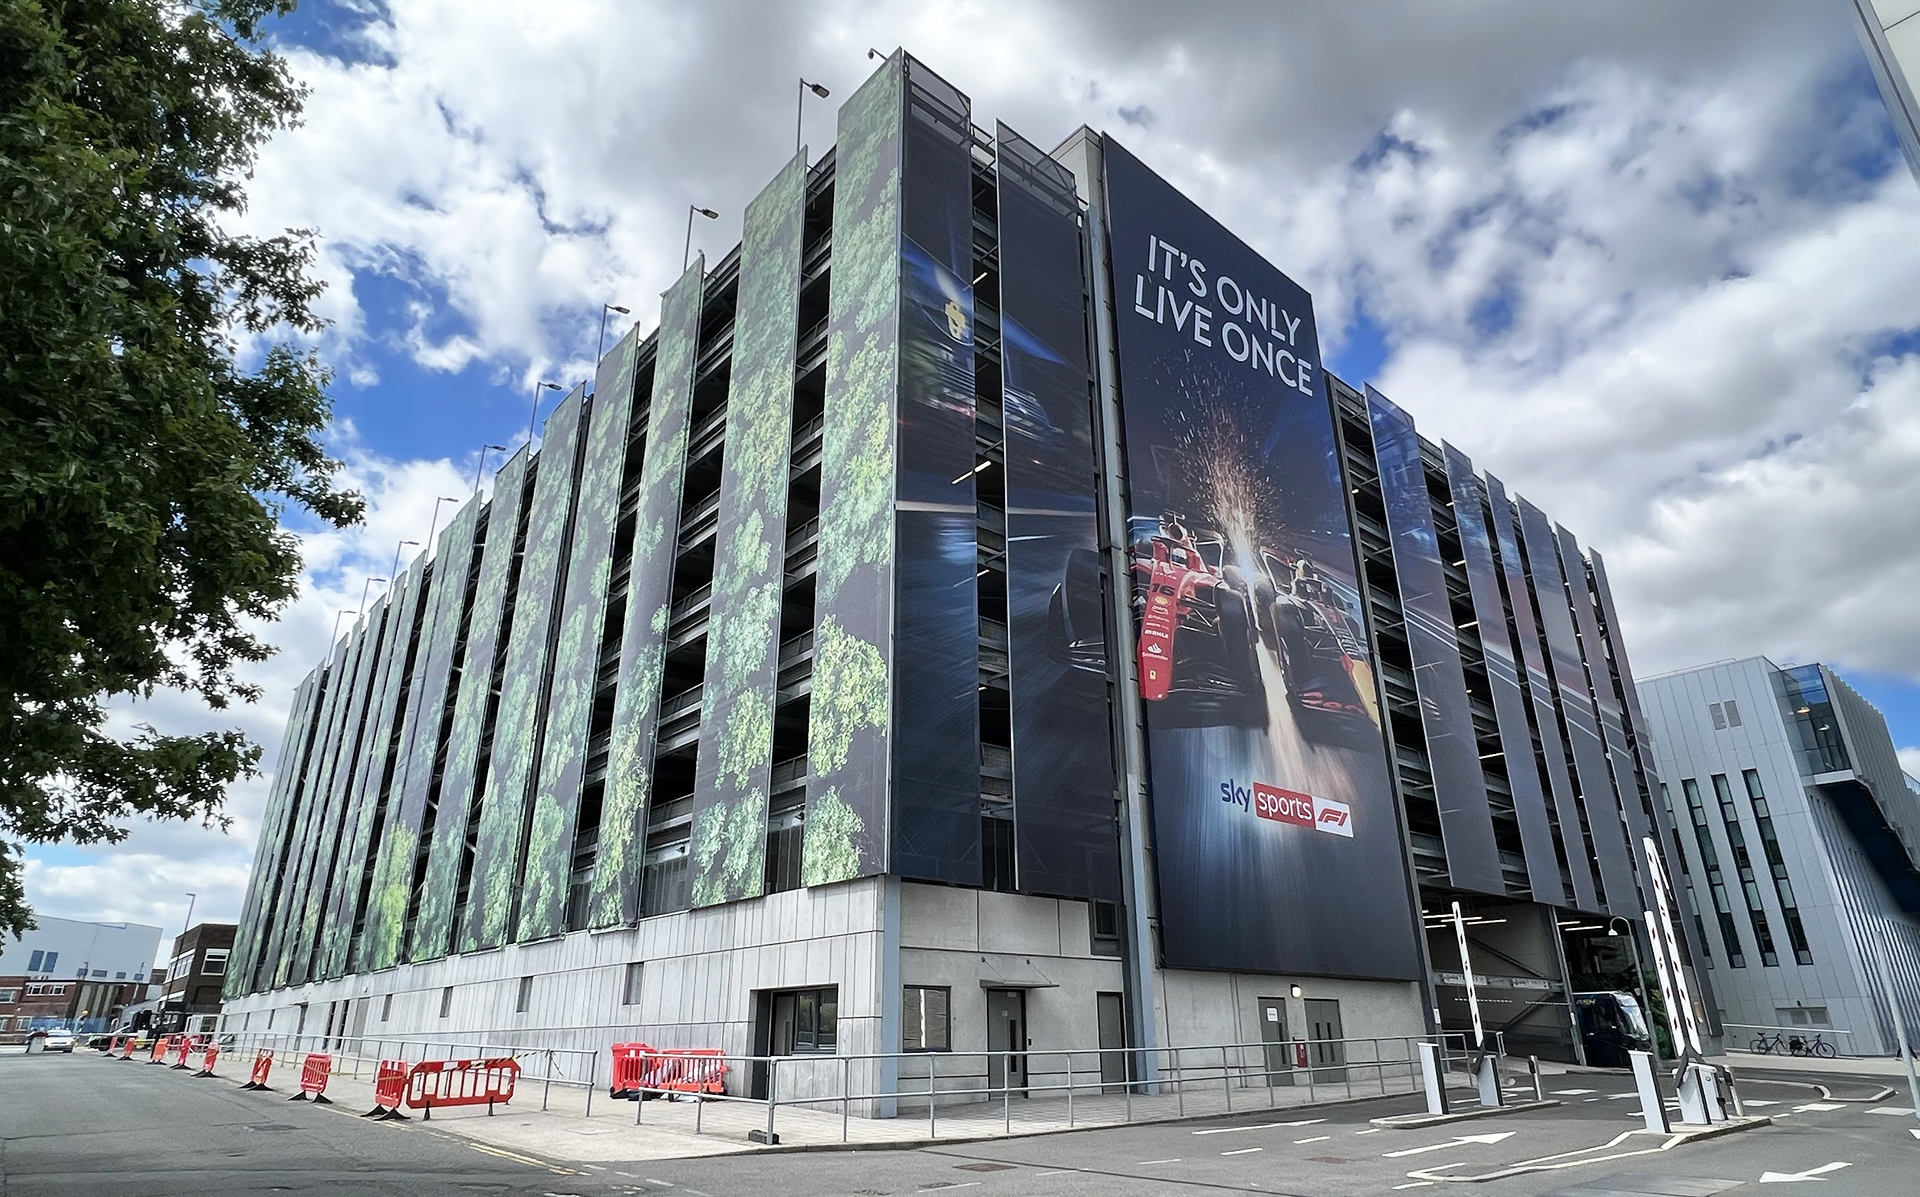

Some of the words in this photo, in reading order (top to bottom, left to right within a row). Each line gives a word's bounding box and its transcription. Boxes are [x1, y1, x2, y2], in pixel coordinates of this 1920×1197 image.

[1148, 234, 1208, 298] IT'S
[1216, 275, 1301, 346] ONLY
[1134, 273, 1213, 348] LIVE
[1221, 321, 1313, 397] ONCE
[1152, 583, 1176, 597] 16
[1220, 778, 1251, 813] sky
[1257, 791, 1313, 821] sports
[1317, 807, 1348, 827] F1
